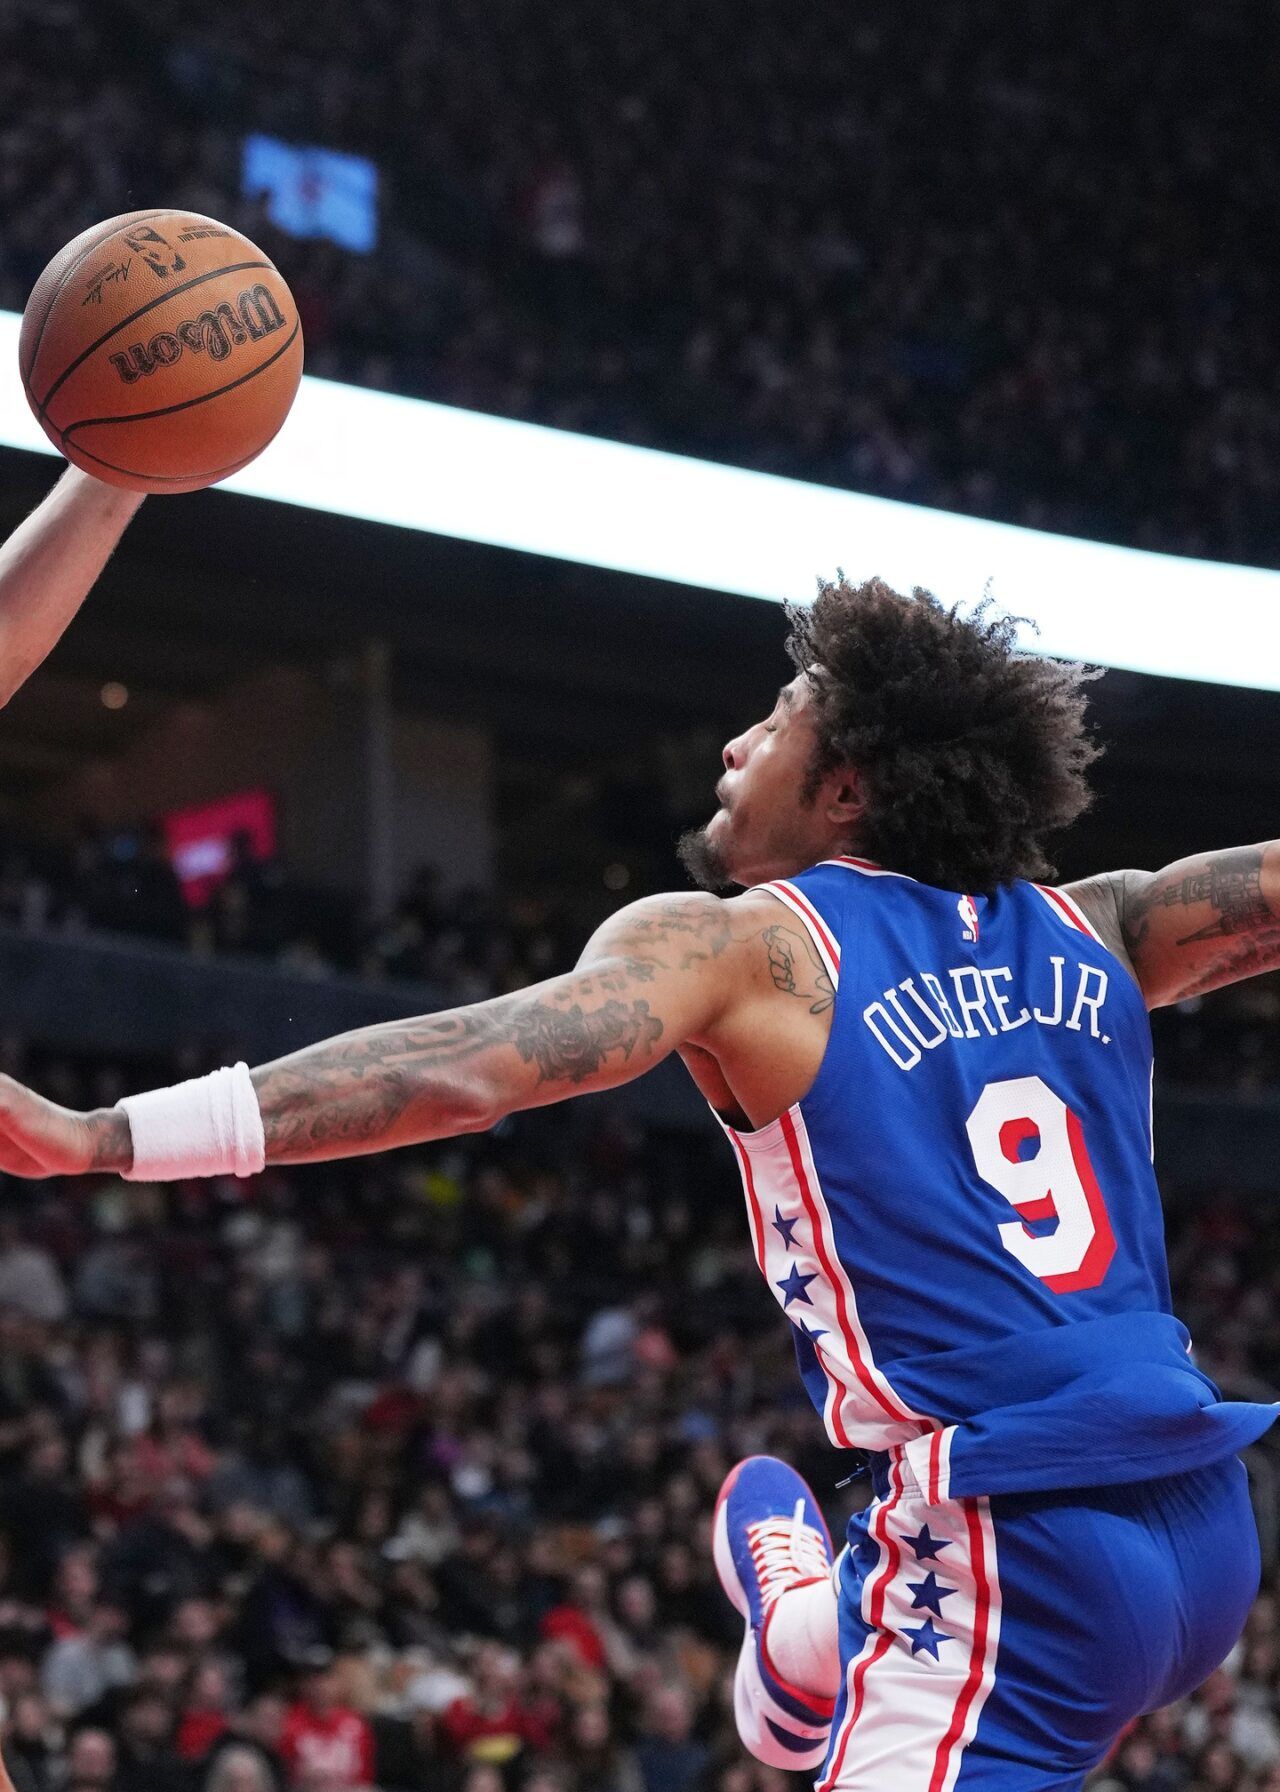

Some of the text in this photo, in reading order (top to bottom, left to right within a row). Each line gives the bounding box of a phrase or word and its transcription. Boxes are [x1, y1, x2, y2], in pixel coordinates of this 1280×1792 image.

[108, 283, 287, 384] Wilson
[863, 956, 1112, 1071] OUBRE JR.
[966, 1076, 1118, 1295] 9
